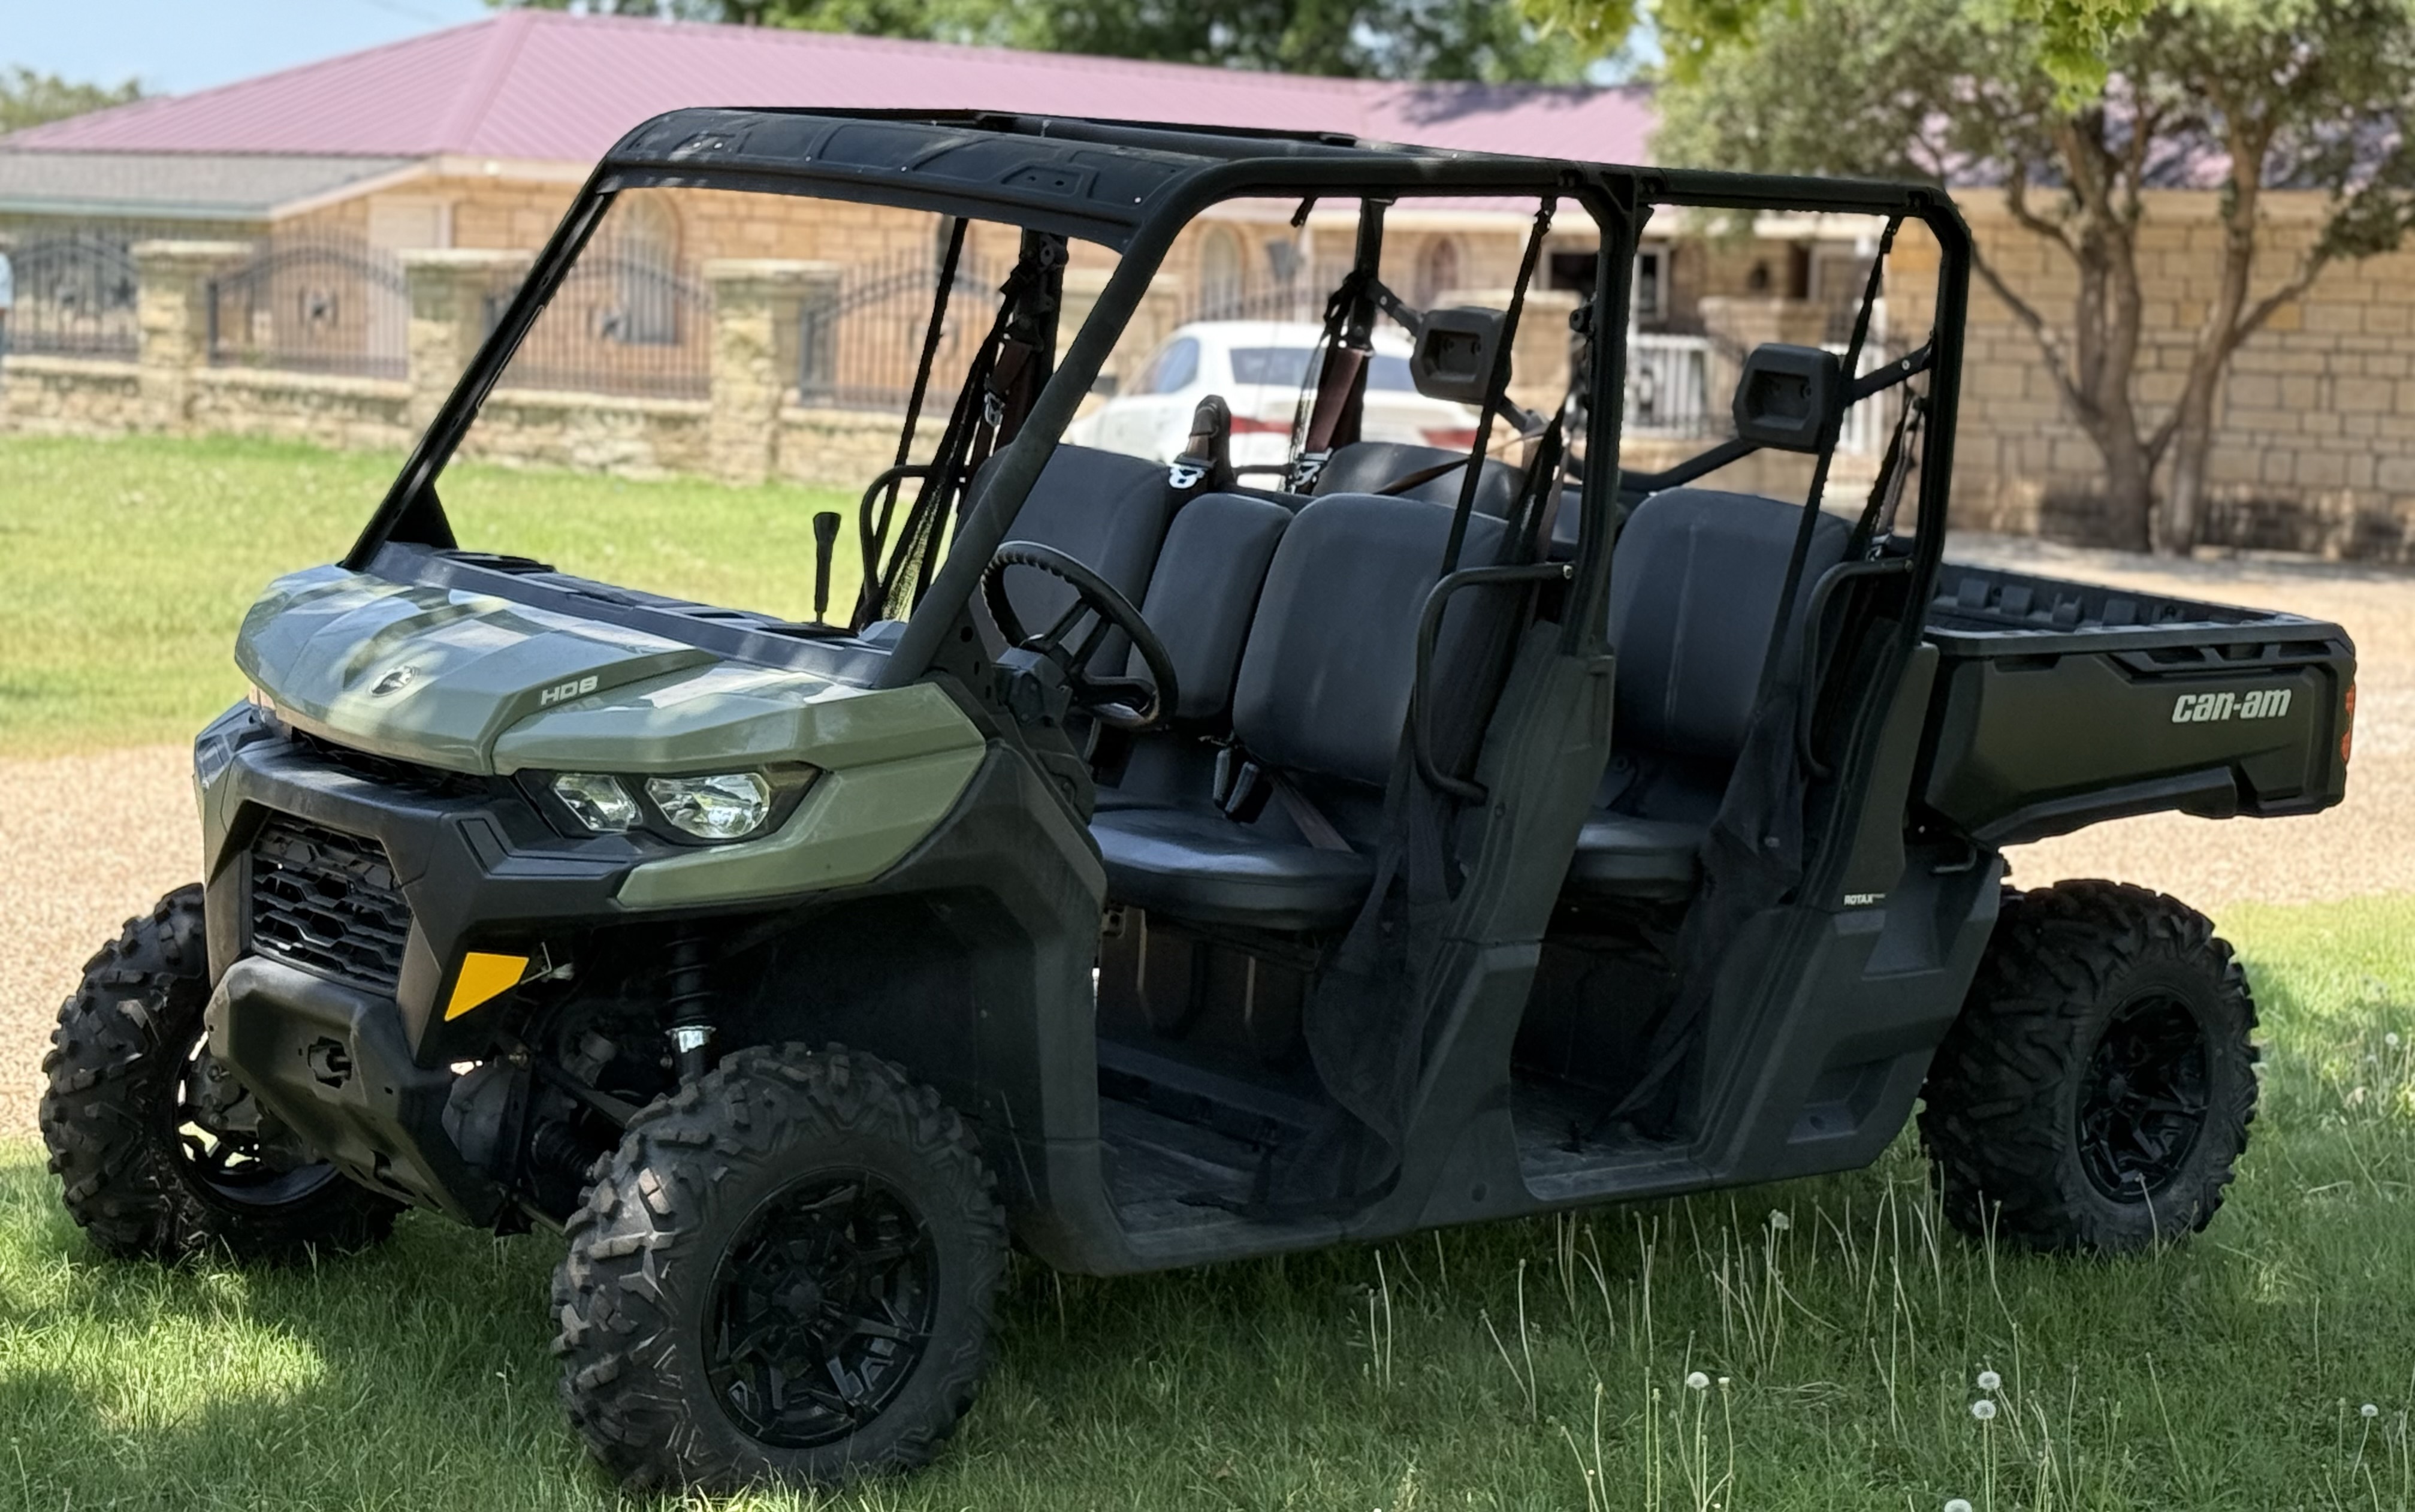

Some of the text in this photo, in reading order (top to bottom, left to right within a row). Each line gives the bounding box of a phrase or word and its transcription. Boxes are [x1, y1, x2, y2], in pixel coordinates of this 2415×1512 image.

[541, 675, 598, 706] HD8
[2172, 689, 2292, 723] can-am
[1844, 894, 1873, 905] ROTAX
